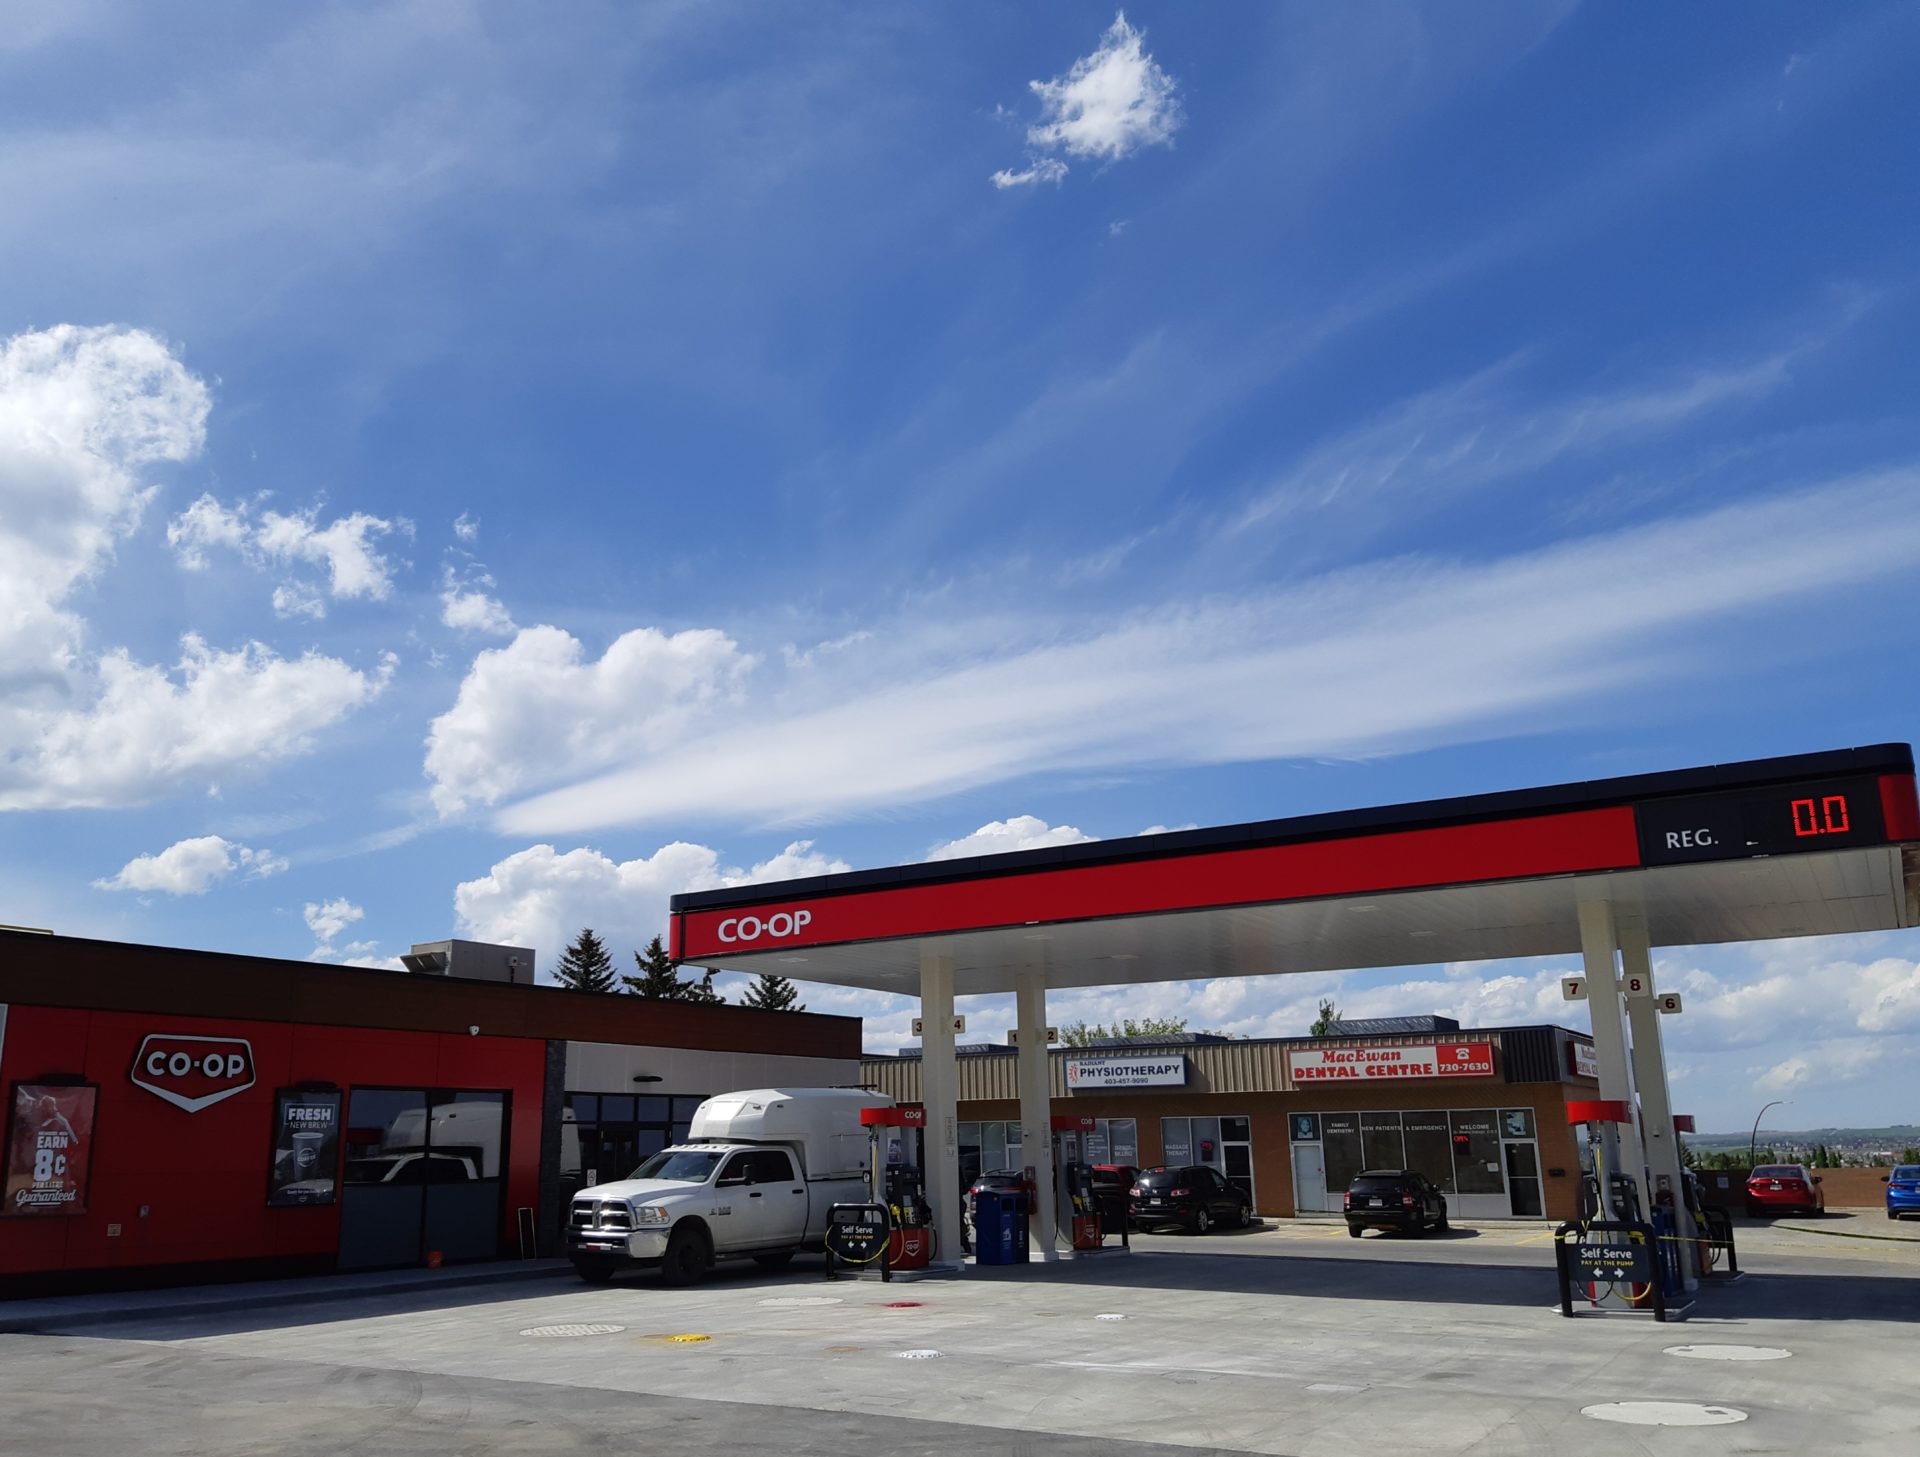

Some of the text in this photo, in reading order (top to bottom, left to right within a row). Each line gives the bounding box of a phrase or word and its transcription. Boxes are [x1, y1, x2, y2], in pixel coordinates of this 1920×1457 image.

[1791, 795, 1850, 836] 0.0
[1666, 828, 1719, 849] REG.
[1568, 982, 1579, 995] 7
[1630, 978, 1641, 991] 8
[1665, 998, 1676, 1009] 6
[916, 1022, 922, 1032] 3
[954, 1019, 961, 1029] 4
[1012, 1033, 1017, 1042] 1
[1047, 1031, 1054, 1040] 2
[1322, 1049, 1402, 1064] MacEwan
[1080, 1065, 1180, 1078] PHYSIOTHERAPY
[1293, 1063, 1433, 1079] DENTAL CENTRE
[1439, 1062, 1489, 1072] 730-7630
[288, 1107, 331, 1121] FRESH
[290, 1121, 328, 1129] NEW BREW
[37, 1136, 68, 1149] EARN
[16, 1188, 77, 1206] Guaranteed
[841, 1225, 874, 1234] Self Serve
[1581, 1248, 1632, 1259] Self Serve
